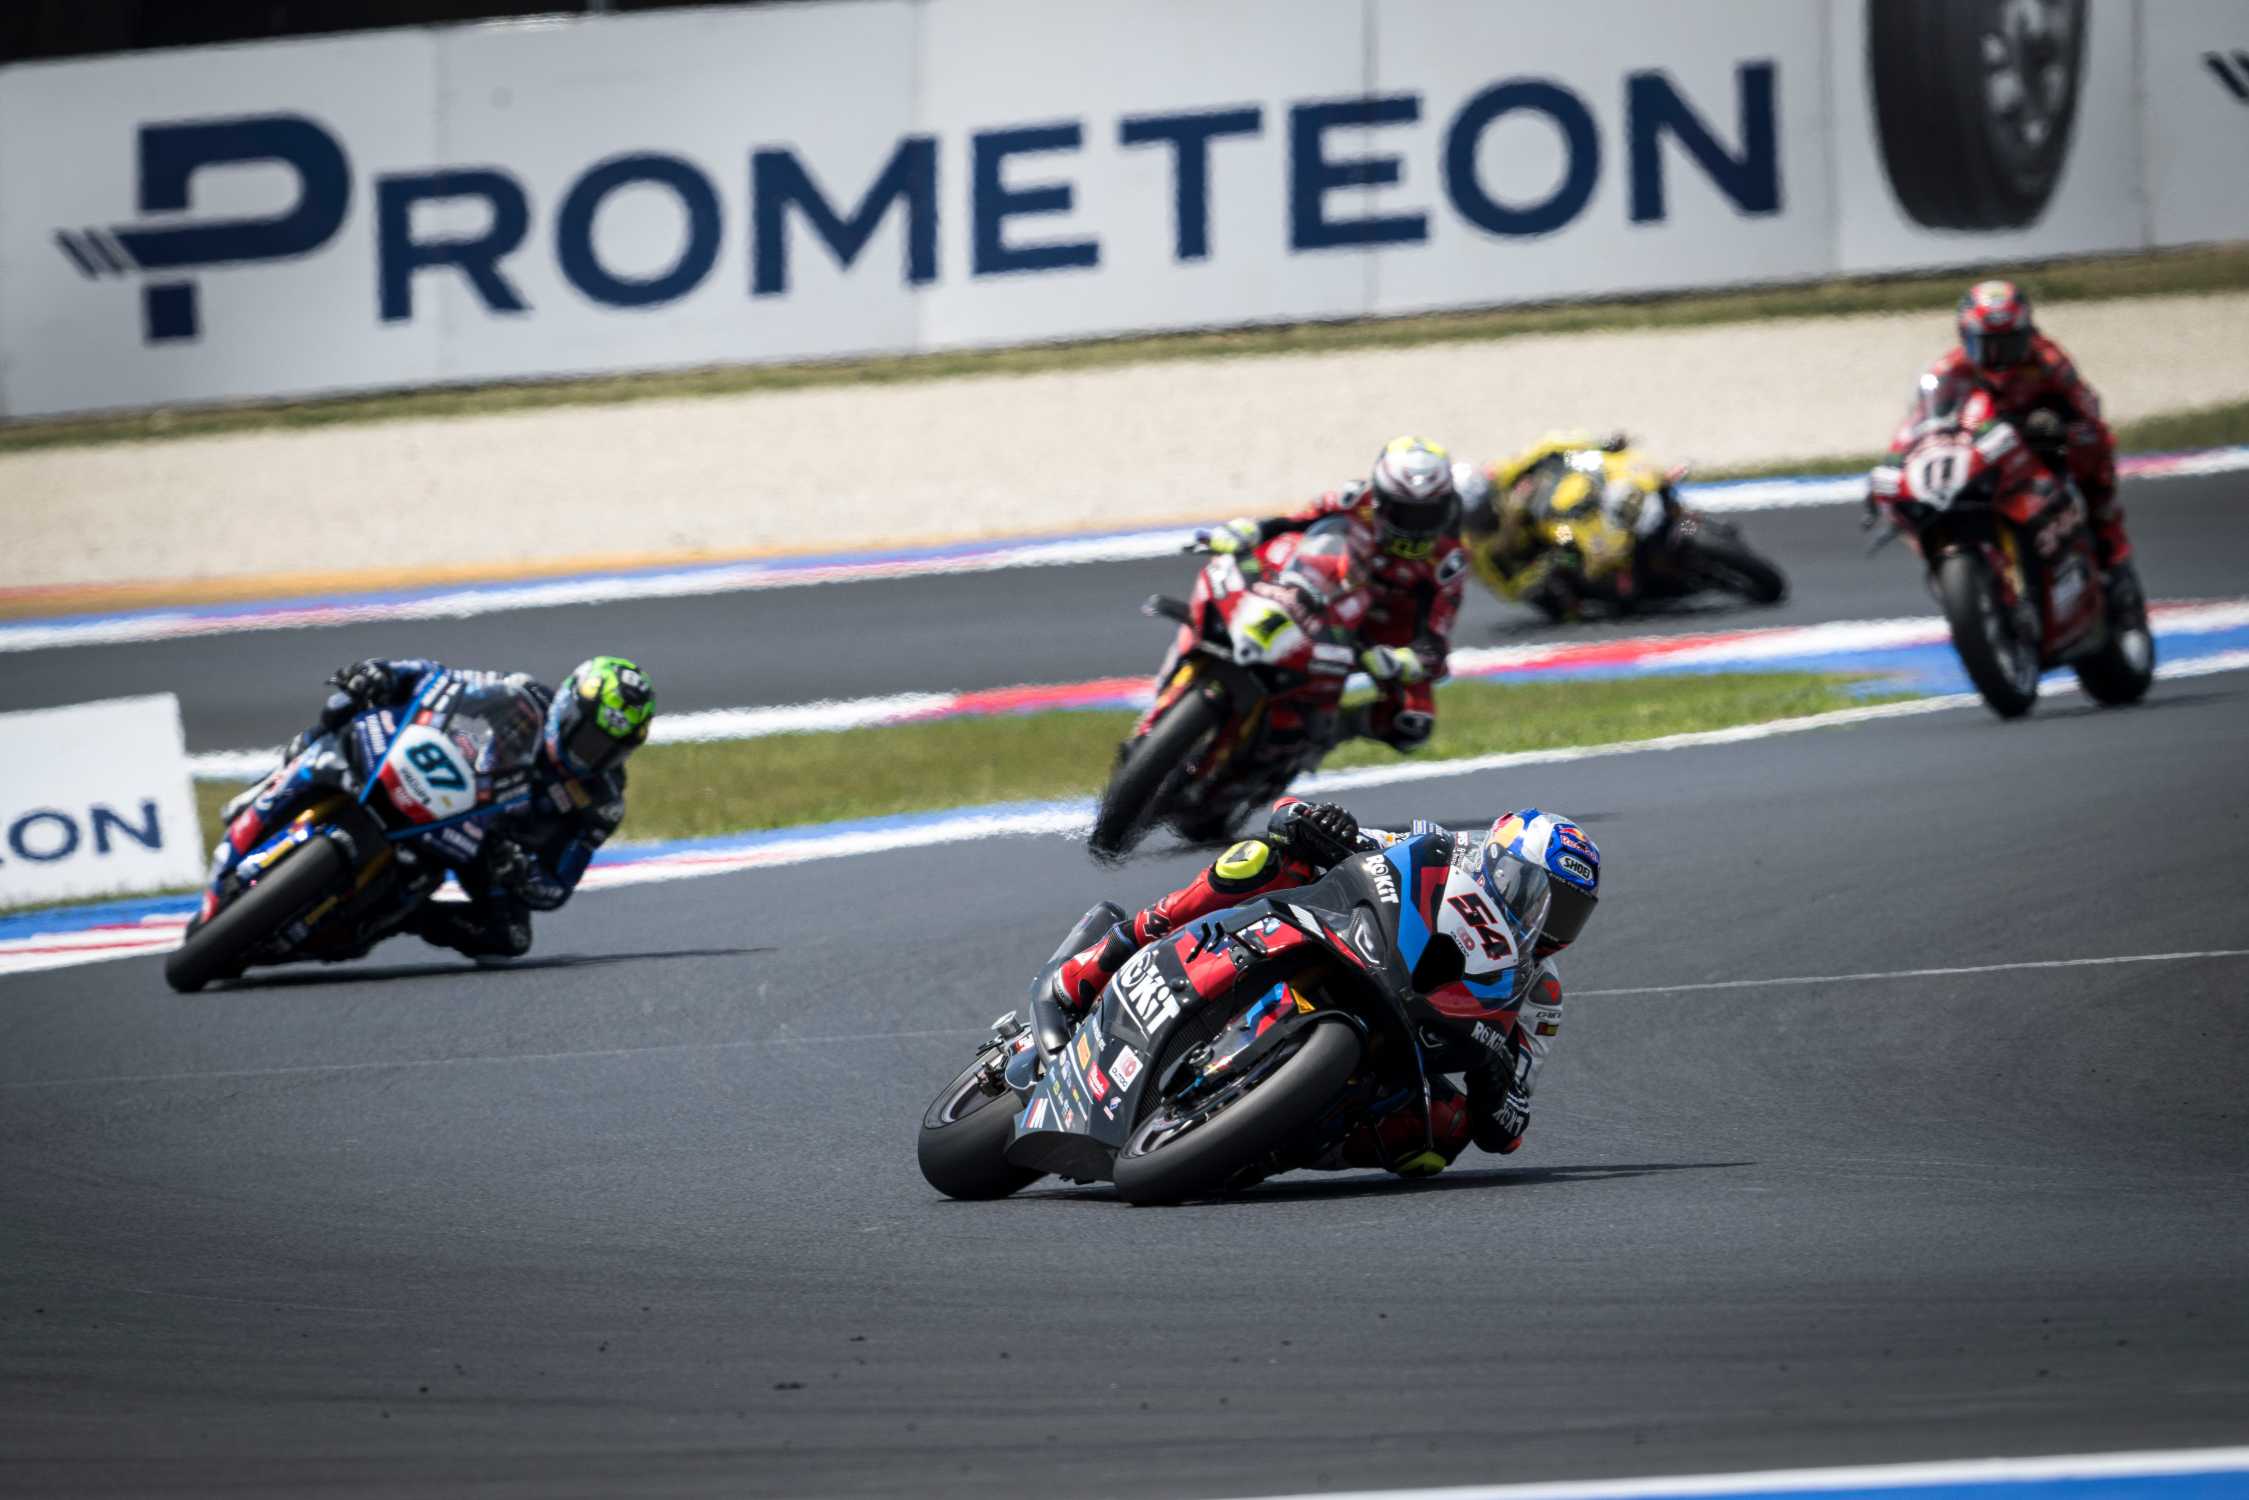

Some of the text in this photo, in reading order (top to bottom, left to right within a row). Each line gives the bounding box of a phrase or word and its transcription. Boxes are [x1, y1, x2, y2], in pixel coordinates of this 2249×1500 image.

[56, 60, 1783, 343] PROMETEON
[405, 742, 467, 791] 87
[0, 800, 162, 863] ON
[1563, 856, 1591, 880] SHOEI
[1446, 892, 1512, 961] 54
